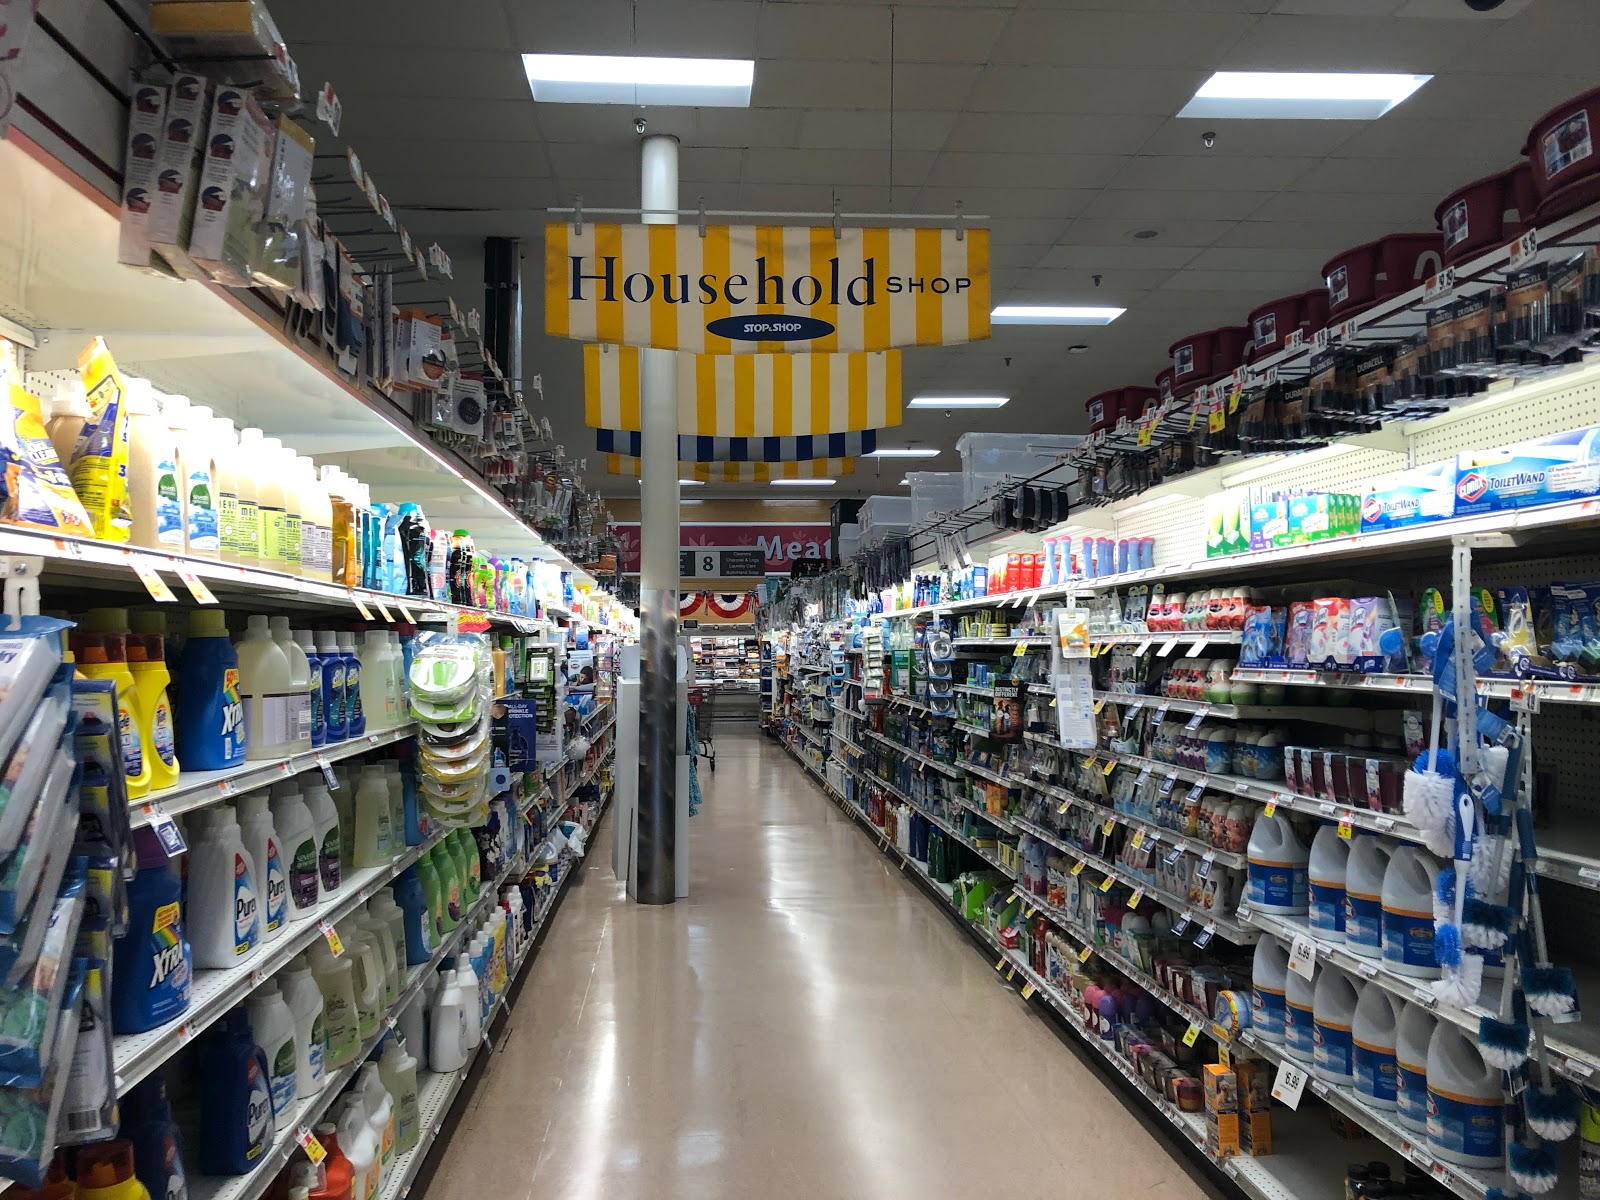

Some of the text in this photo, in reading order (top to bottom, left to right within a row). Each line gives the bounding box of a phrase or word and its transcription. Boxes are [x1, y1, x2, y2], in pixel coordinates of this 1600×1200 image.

[567, 255, 972, 307] Household SHOP
[1356, 356, 1384, 373] DURACELL
[756, 535, 832, 561] Meat
[702, 556, 714, 571] 8
